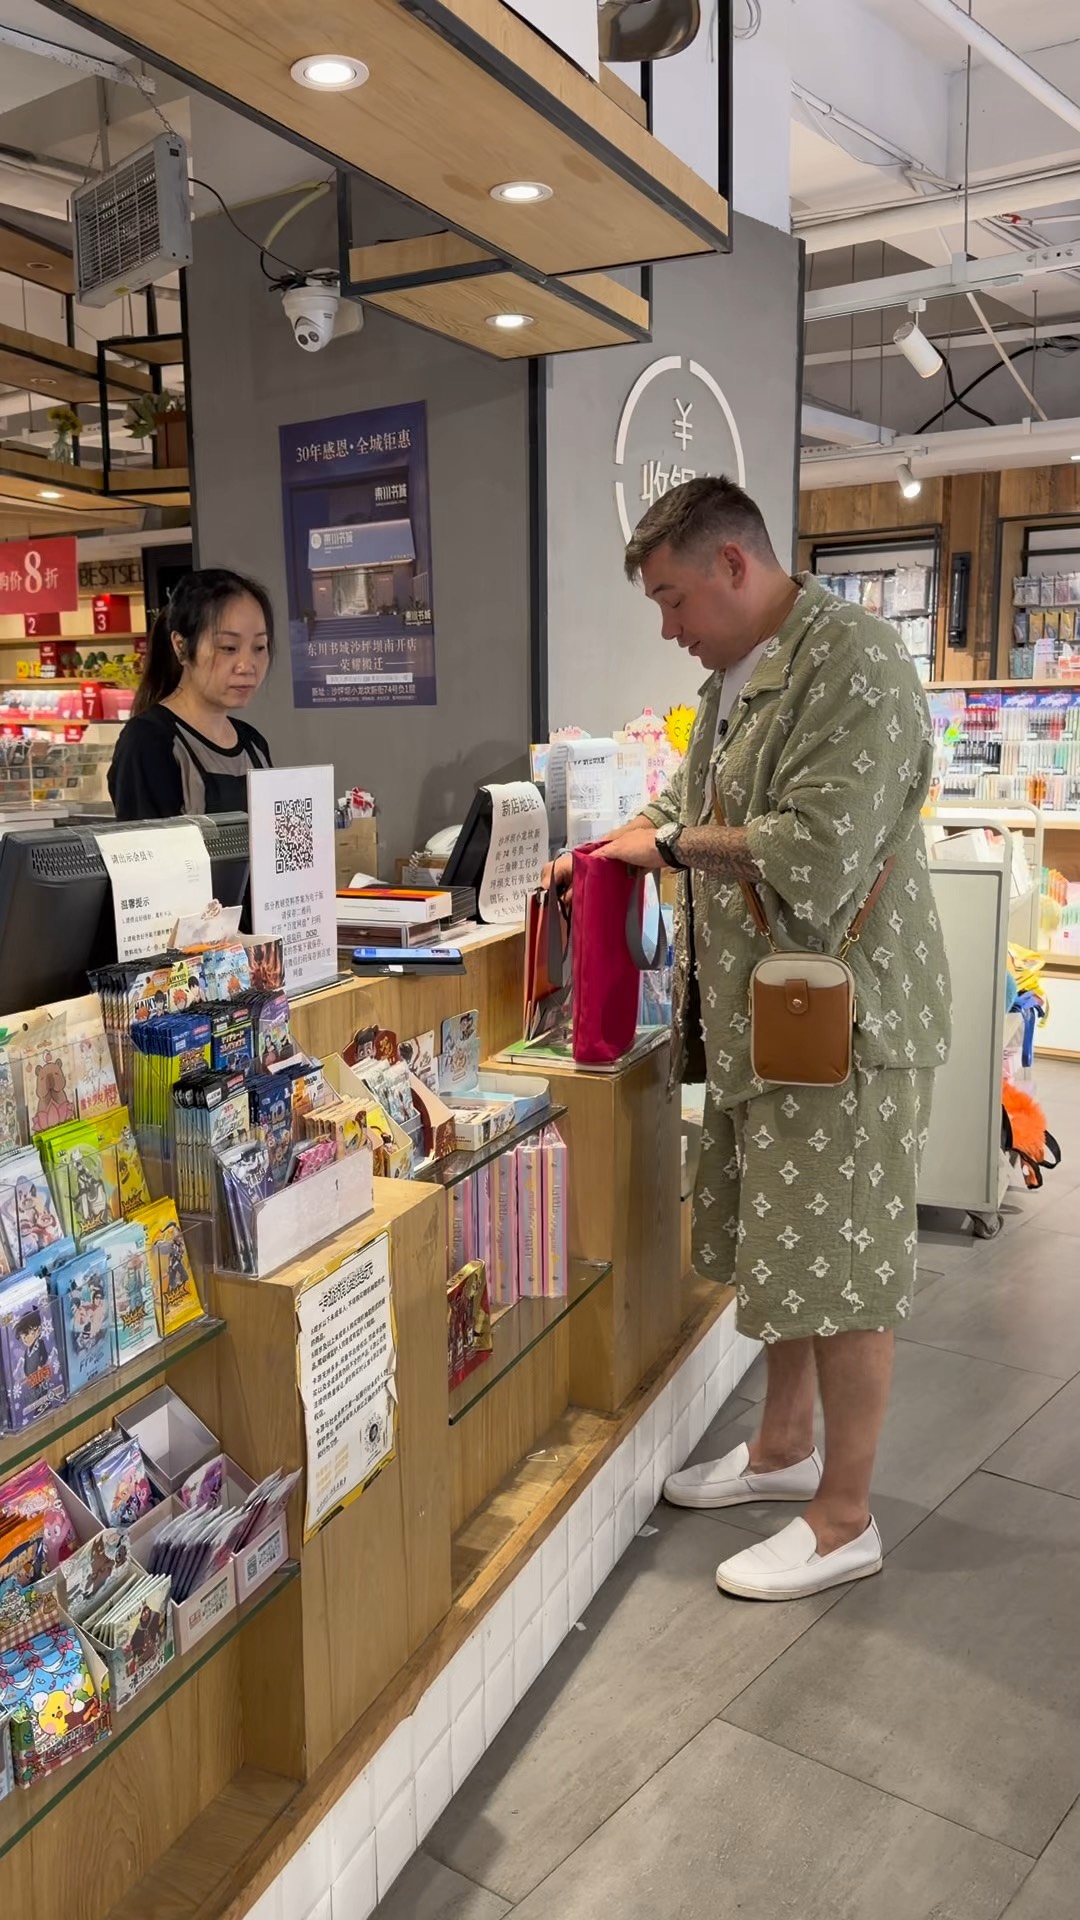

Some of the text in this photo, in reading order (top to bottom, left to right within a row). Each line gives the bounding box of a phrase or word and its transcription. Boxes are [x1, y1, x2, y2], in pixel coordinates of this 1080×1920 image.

[28, 617, 36, 634] 2
[97, 614, 107, 631] 3
[86, 699, 94, 717] 7
